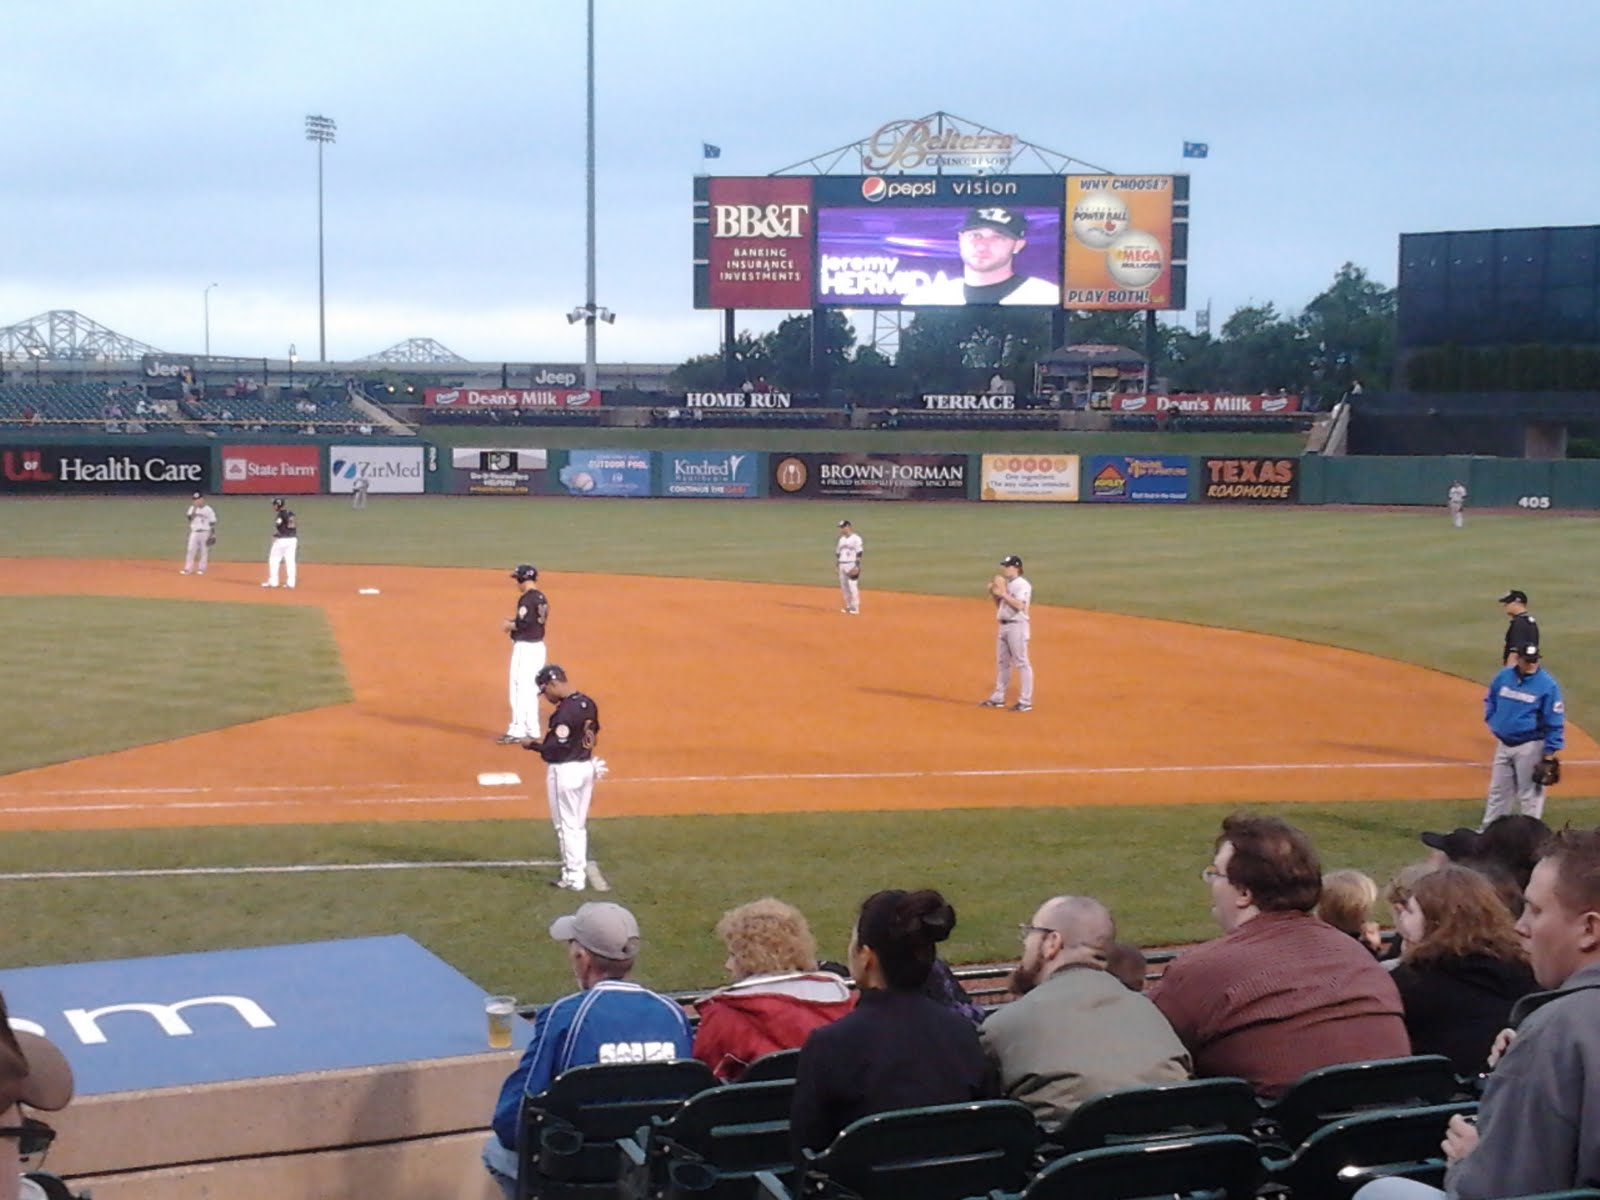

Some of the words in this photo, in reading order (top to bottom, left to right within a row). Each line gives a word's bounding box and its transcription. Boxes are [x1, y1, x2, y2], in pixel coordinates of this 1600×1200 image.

[888, 182, 937, 197] pepsi
[953, 180, 1017, 195] vision
[1080, 180, 1109, 190] WHY
[1112, 180, 1168, 190] CHOOSE?
[714, 204, 808, 238] BB&T
[733, 248, 787, 257] BANKING
[1123, 249, 1160, 261] MEGA
[726, 260, 795, 270] INSURANCE
[719, 272, 801, 281] INVESTMENTS
[1067, 290, 1104, 303] PLAY
[1107, 290, 1150, 303] BOTH!
[535, 369, 576, 387] Jeep
[468, 390, 518, 405] Dean's
[521, 391, 558, 406] Milk
[686, 393, 745, 408] HOME
[750, 393, 792, 408] RUN
[922, 394, 1016, 410] TERRACE
[1213, 396, 1252, 412] Milk
[59, 457, 142, 481] Health
[144, 458, 202, 482] Care
[247, 463, 278, 476] State
[280, 463, 315, 476] Farm
[358, 461, 421, 478] ZirMed
[674, 459, 729, 475] Kindred
[820, 463, 963, 480] BROWN-FORMAN
[1207, 460, 1292, 483] TEXAS
[1207, 485, 1290, 498] ROADHOUSE
[1518, 496, 1550, 508] 405
